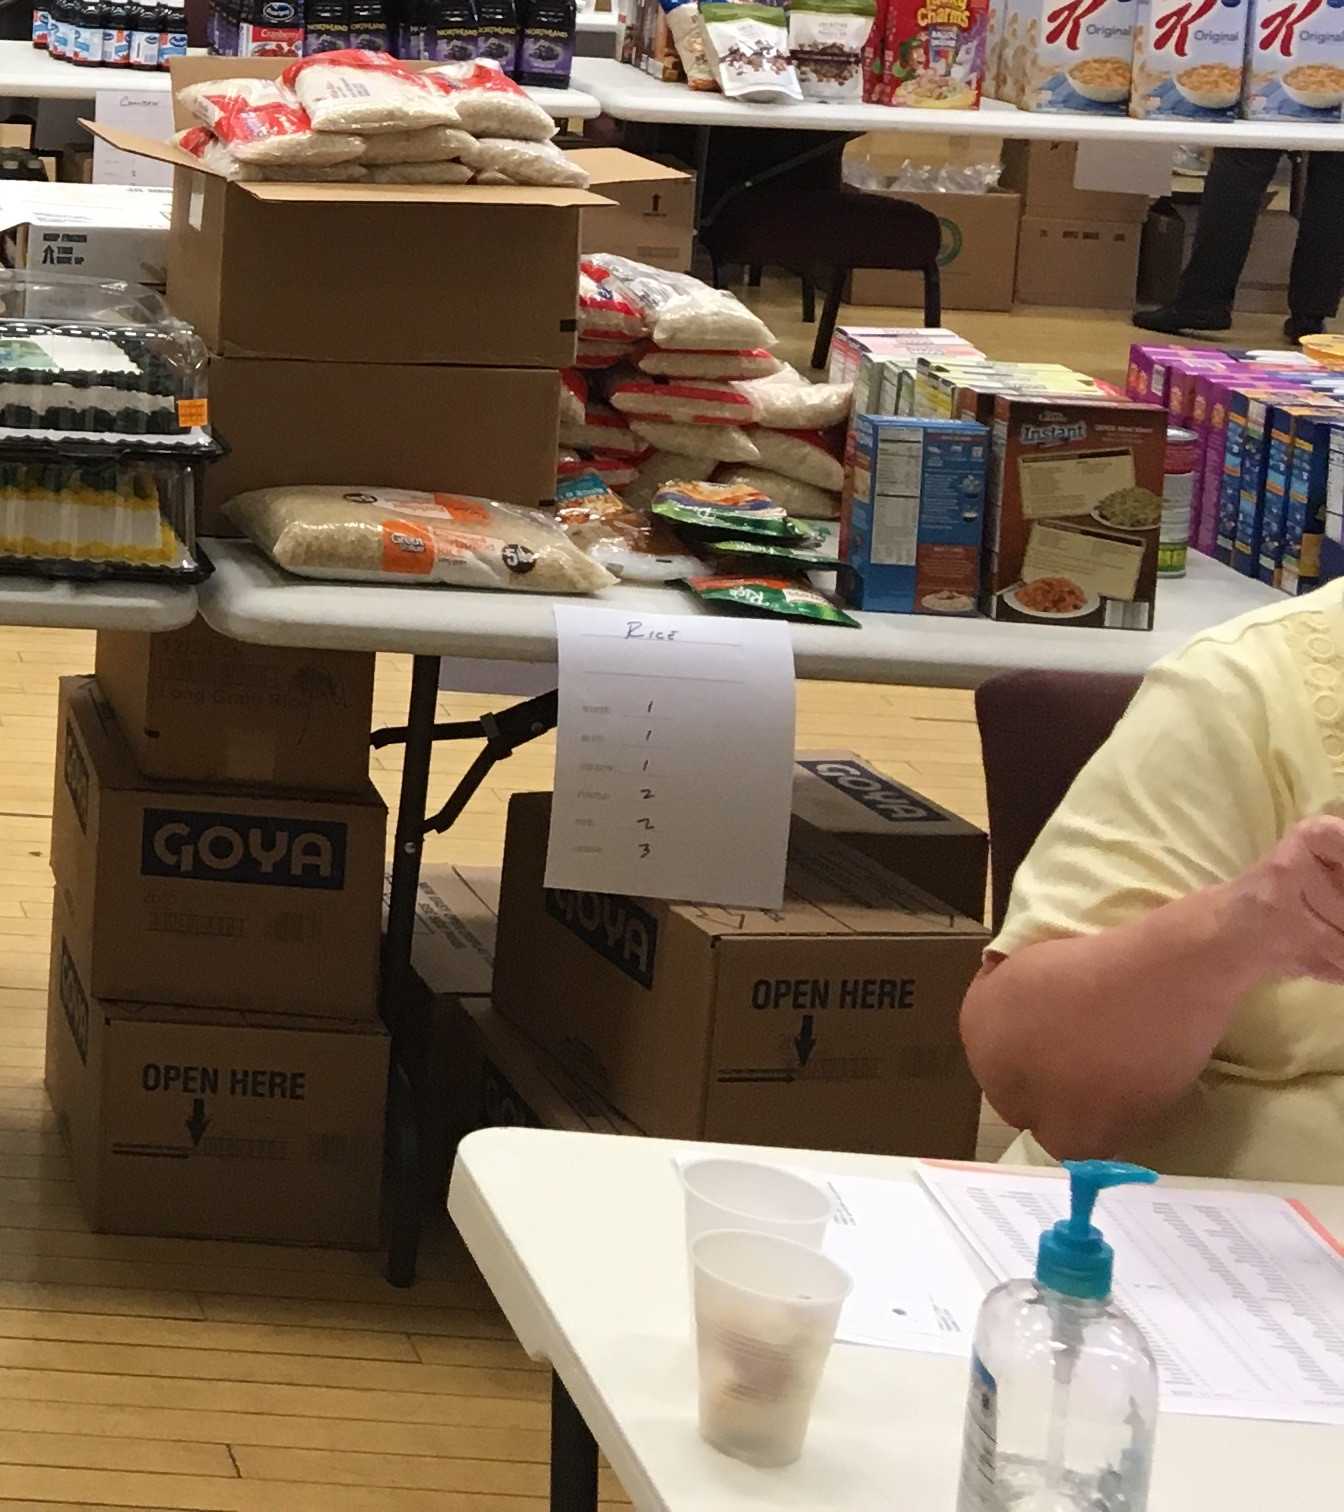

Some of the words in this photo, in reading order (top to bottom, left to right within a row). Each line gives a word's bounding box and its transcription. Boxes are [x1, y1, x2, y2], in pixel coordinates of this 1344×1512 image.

[917, 6, 970, 28] Charms
[524, 27, 569, 38] NORTHLAND
[1086, 23, 1132, 38] Original
[1194, 29, 1239, 44] Original
[1023, 424, 1084, 440] Instant
[390, 533, 424, 546] Great
[640, 788, 656, 800] 2
[815, 762, 931, 823] GOYA
[636, 817, 655, 830] 2
[153, 821, 334, 877] GOYA
[638, 843, 652, 859] 3
[751, 979, 831, 1010] OPEN
[840, 979, 915, 1009] HERE
[142, 1063, 218, 1096] OPEN
[230, 1069, 306, 1100] HERE
